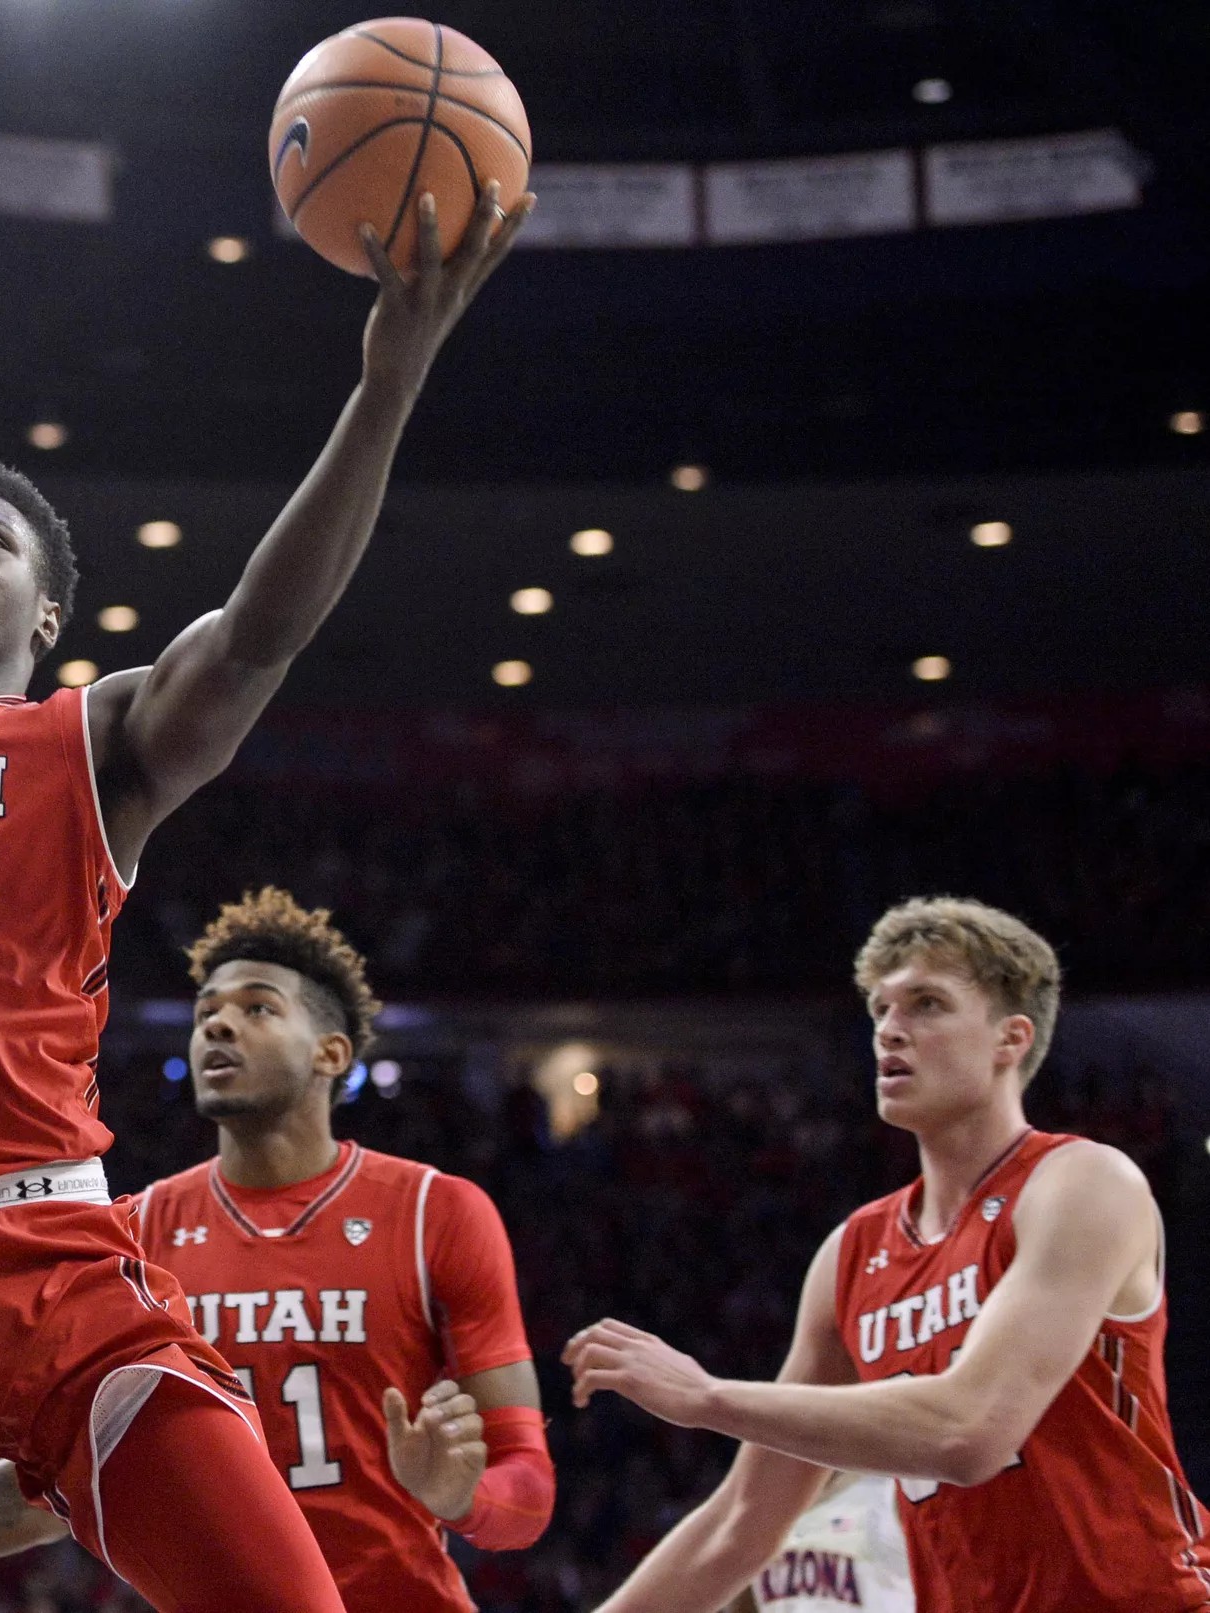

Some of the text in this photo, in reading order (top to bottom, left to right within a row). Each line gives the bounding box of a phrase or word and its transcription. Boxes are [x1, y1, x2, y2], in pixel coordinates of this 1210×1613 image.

[189, 1289, 368, 1345] UTAH
[857, 1263, 983, 1364] UTAH
[233, 1363, 343, 1490] 1
